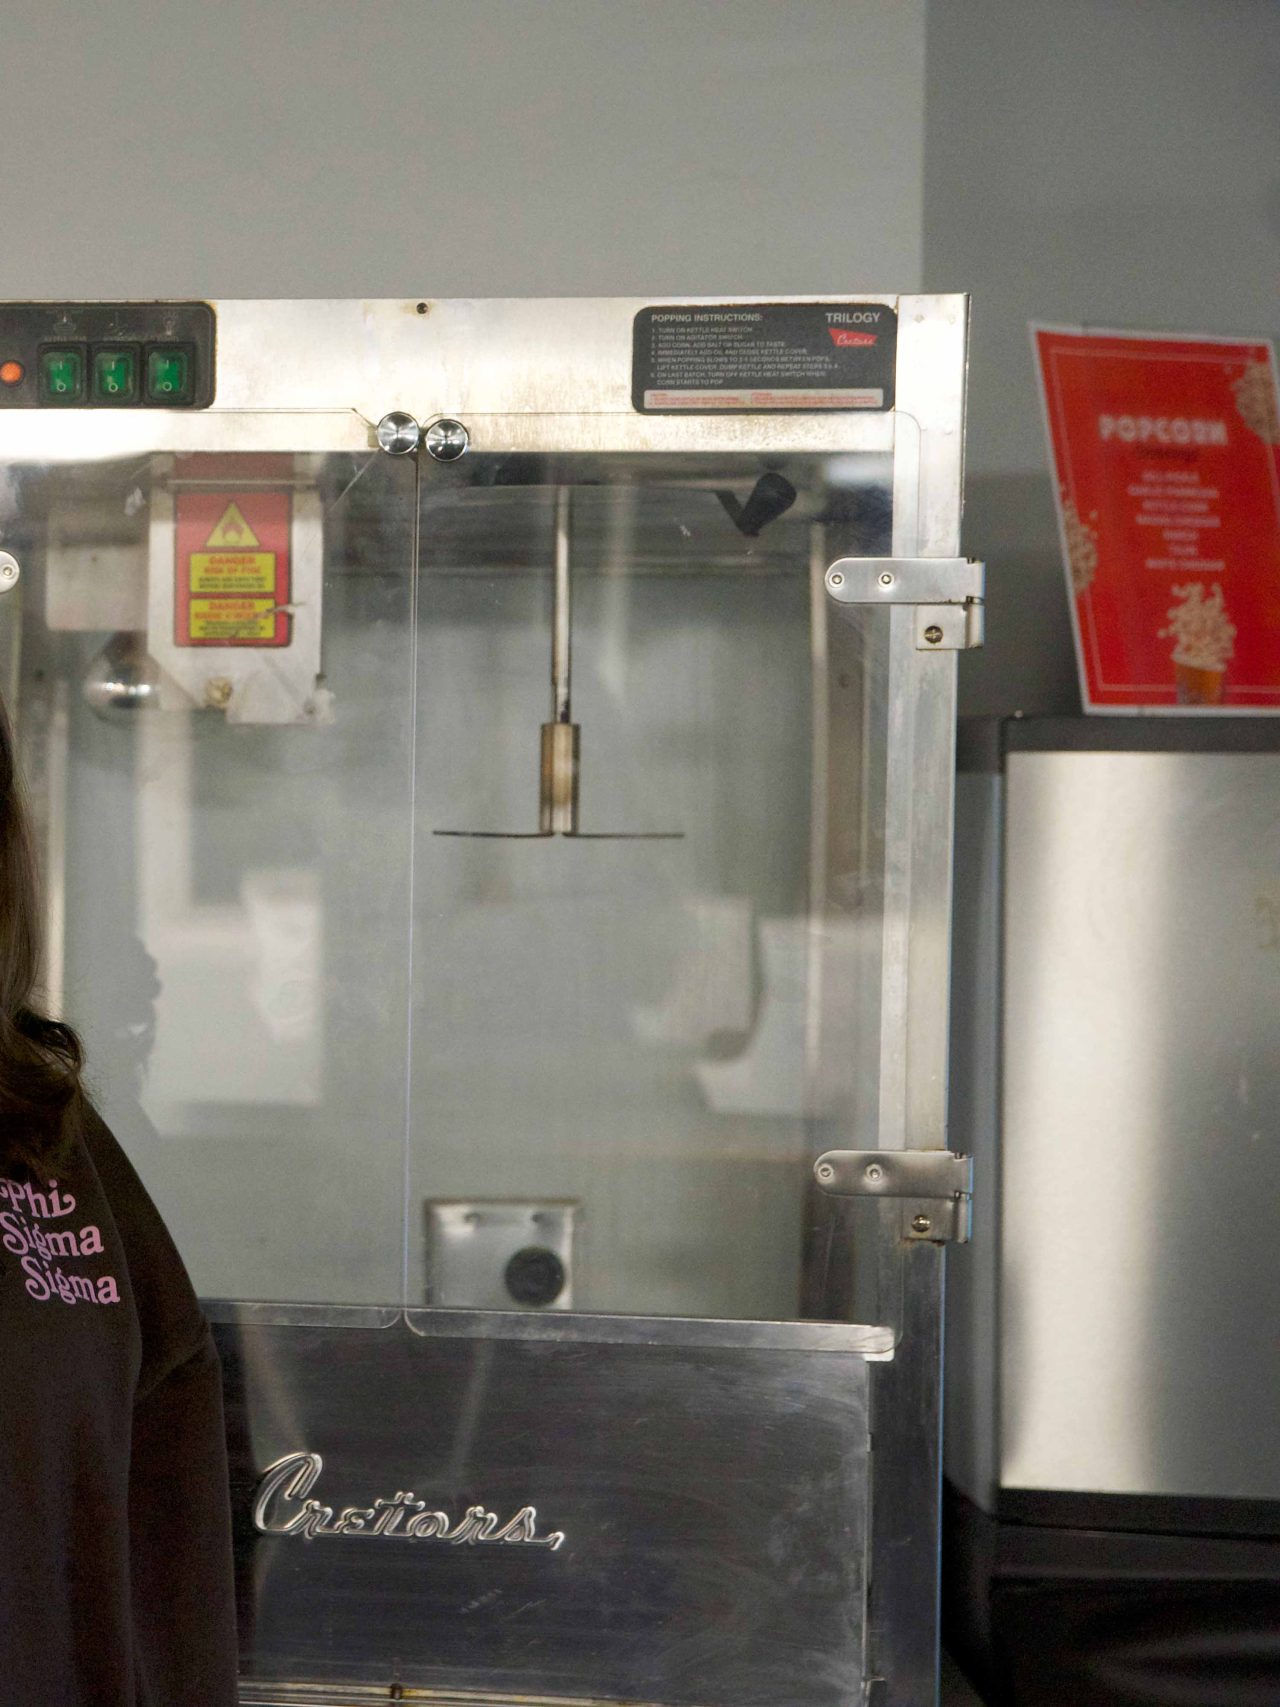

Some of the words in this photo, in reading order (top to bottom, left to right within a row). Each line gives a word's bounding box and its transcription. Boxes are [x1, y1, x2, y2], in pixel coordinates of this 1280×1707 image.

[651, 313, 691, 323] POPPING
[694, 313, 763, 322] INSTRUCTIONS:
[825, 312, 880, 323] TRILOGY
[1098, 413, 1228, 446] POPCORN
[21, 1255, 121, 1305] Sigma
